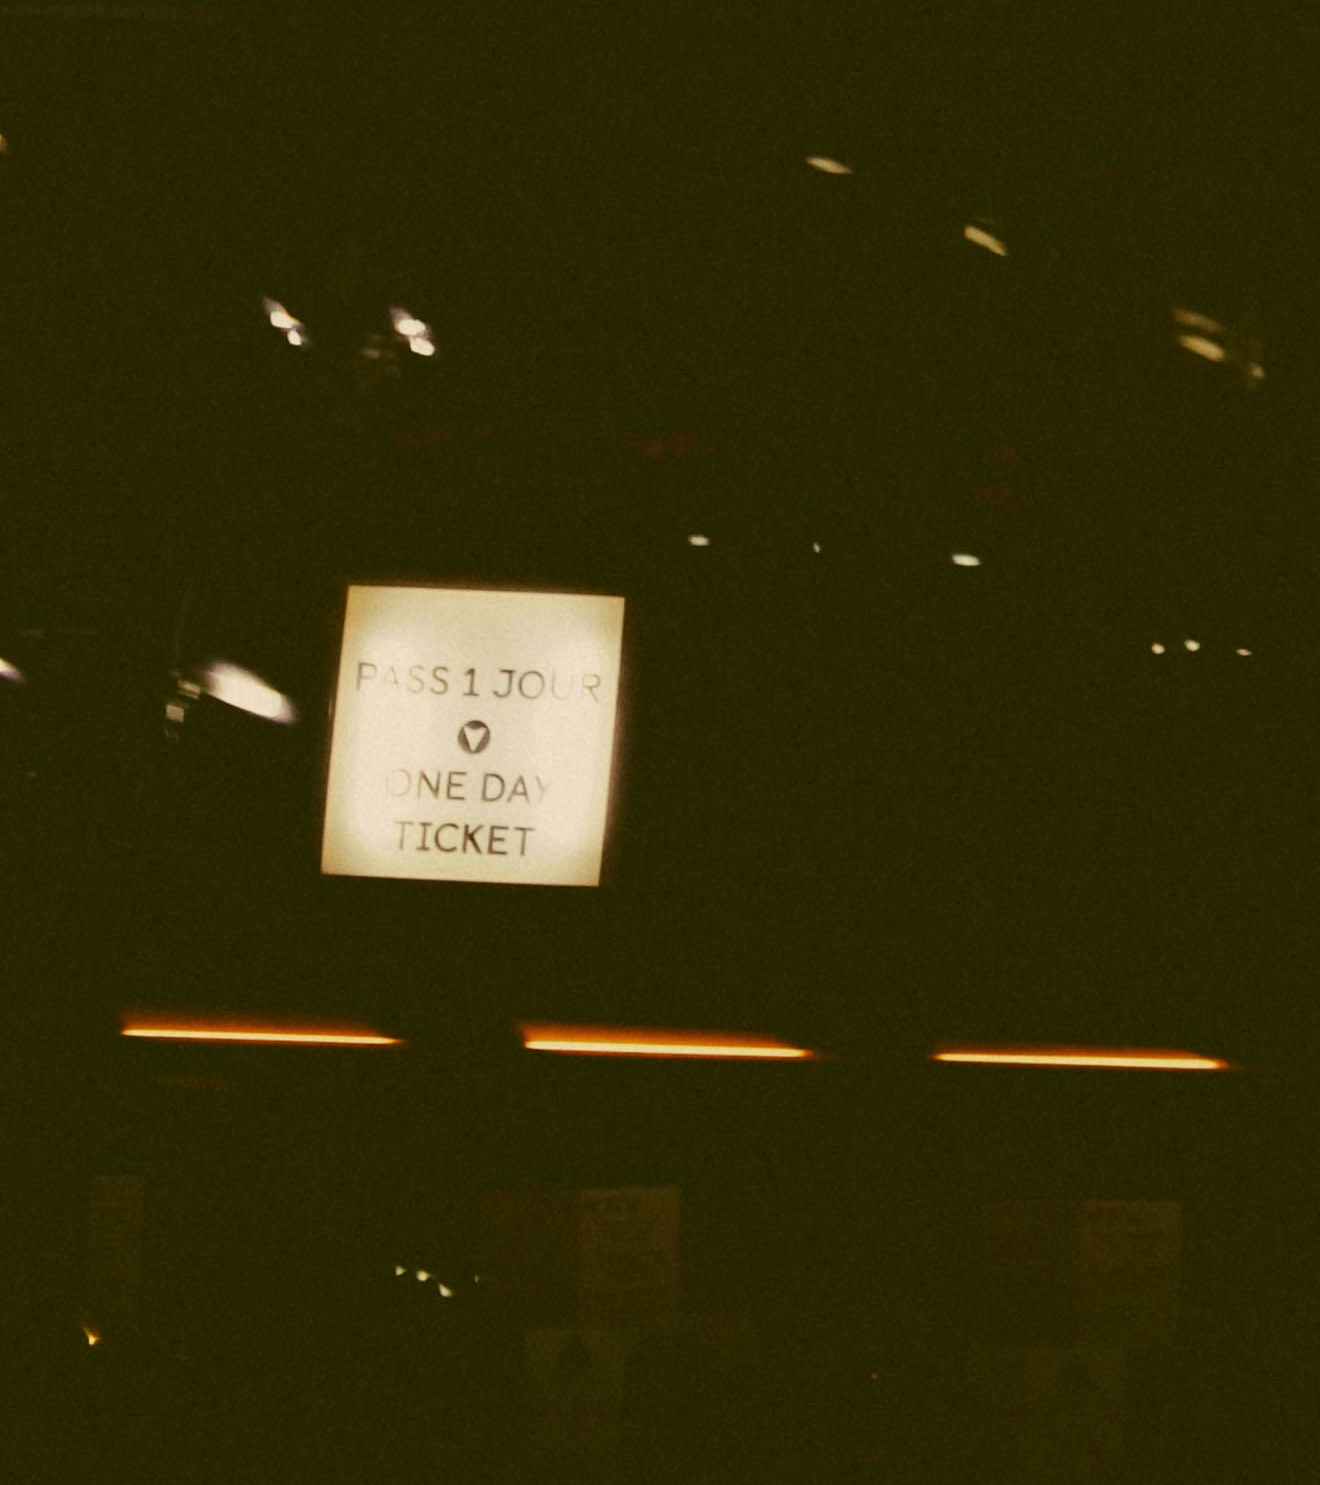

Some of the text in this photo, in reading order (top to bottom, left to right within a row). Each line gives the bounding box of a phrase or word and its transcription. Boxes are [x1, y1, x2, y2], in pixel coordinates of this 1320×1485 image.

[356, 661, 600, 703] PASS 1 JOUR
[386, 769, 548, 803] ONE DAY
[395, 821, 535, 857] TICKET
